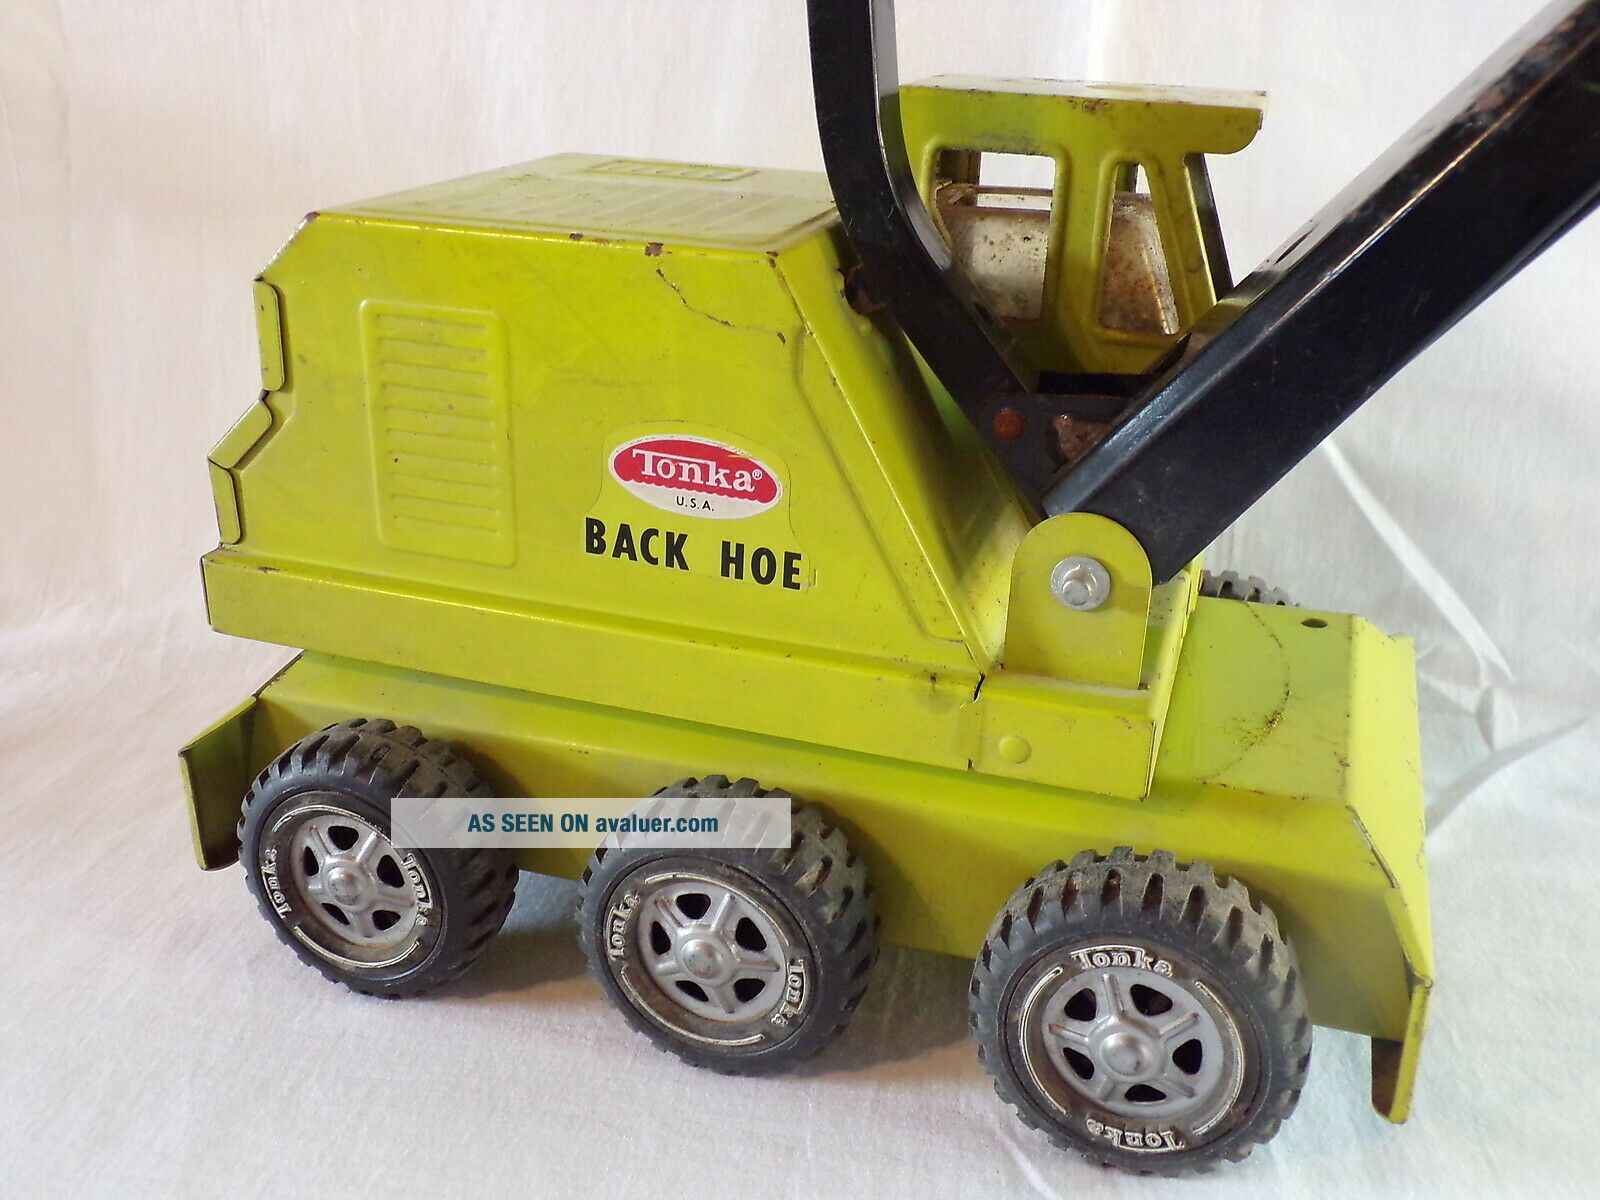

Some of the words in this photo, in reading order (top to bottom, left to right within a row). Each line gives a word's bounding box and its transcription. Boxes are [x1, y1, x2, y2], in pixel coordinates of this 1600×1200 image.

[676, 496, 715, 511] U.S.A.
[585, 517, 689, 571] BACK
[720, 540, 802, 590] HOE
[261, 848, 292, 919] Tonka
[401, 852, 433, 927] Tonka
[606, 893, 641, 962] Tonka
[1070, 944, 1173, 978] Tonka
[771, 958, 805, 1026] Tonka
[1086, 1118, 1185, 1152] Tonka
